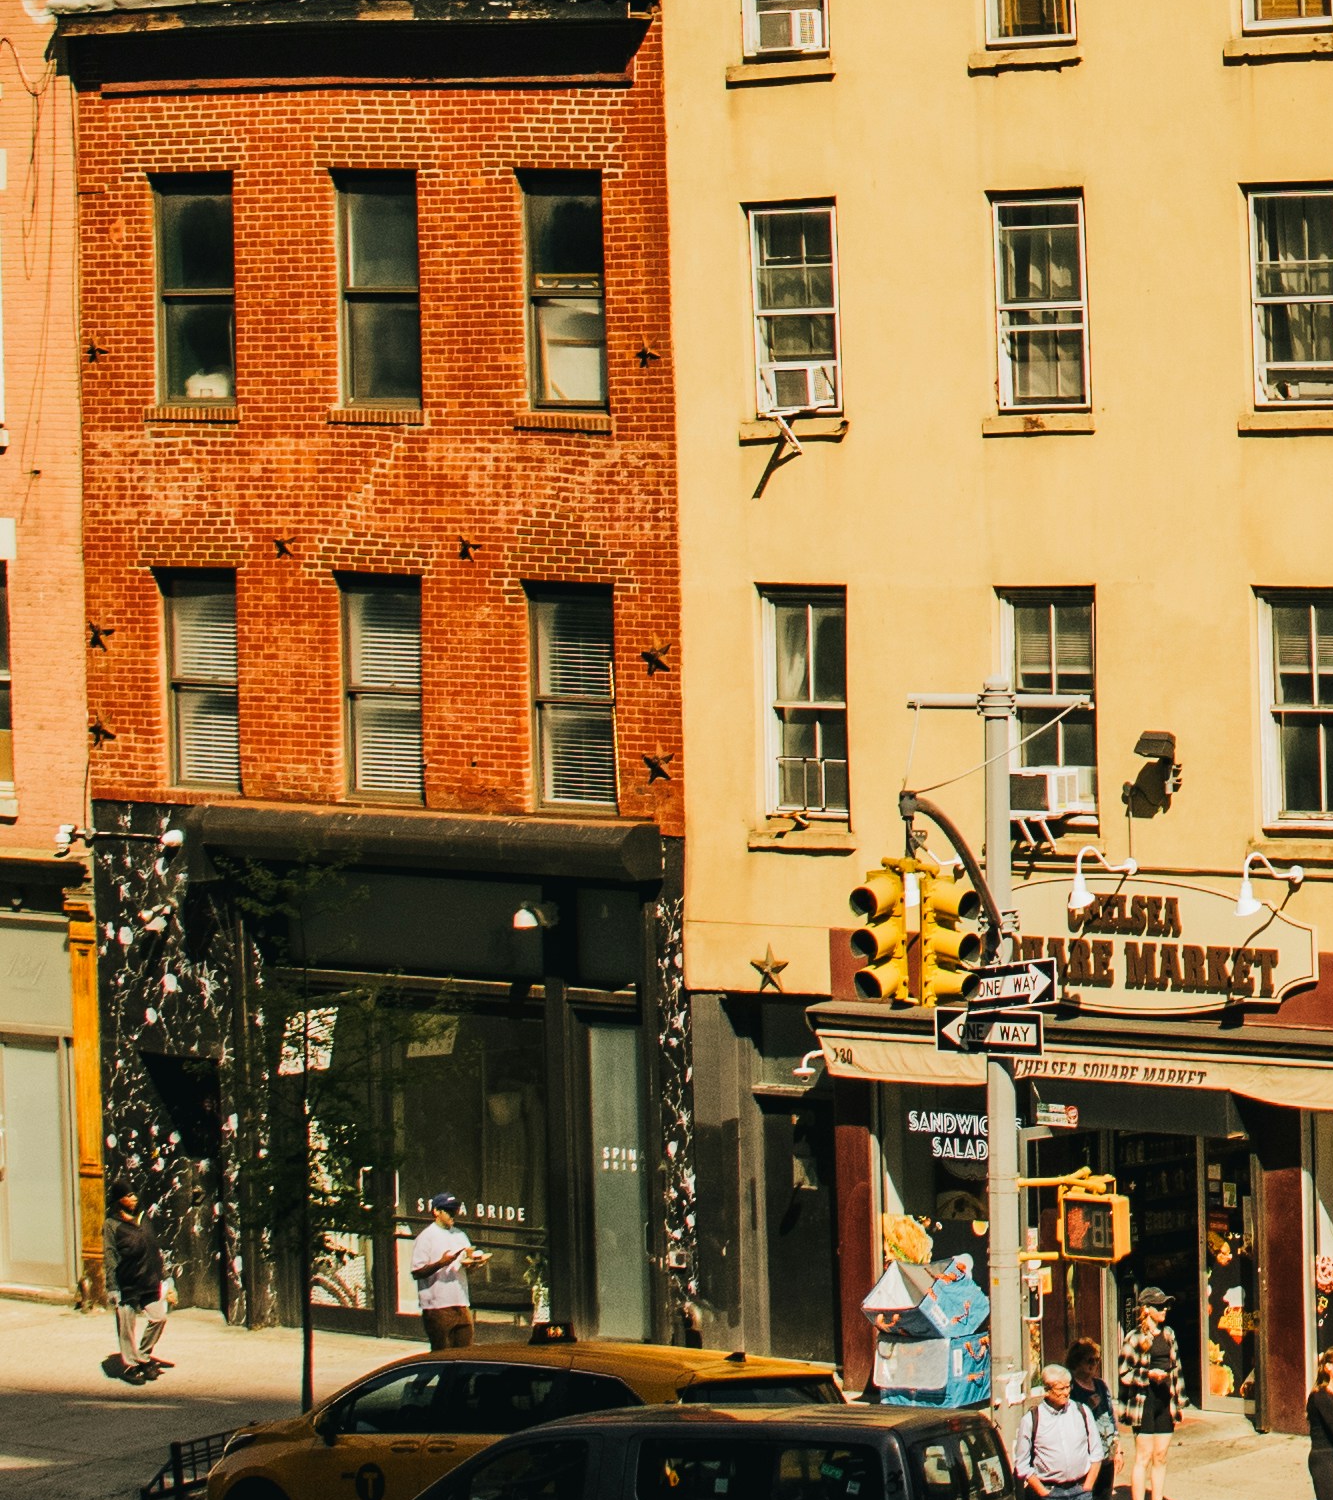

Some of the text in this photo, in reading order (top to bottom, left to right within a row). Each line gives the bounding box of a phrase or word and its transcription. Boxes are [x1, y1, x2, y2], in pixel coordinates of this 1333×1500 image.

[1067, 893, 1183, 939] CHELSEA
[1124, 940, 1280, 999] MARKET
[978, 974, 1039, 997] ONE WAY
[956, 1023, 1030, 1043] ONE WAY
[475, 1203, 525, 1222] BRIDE
